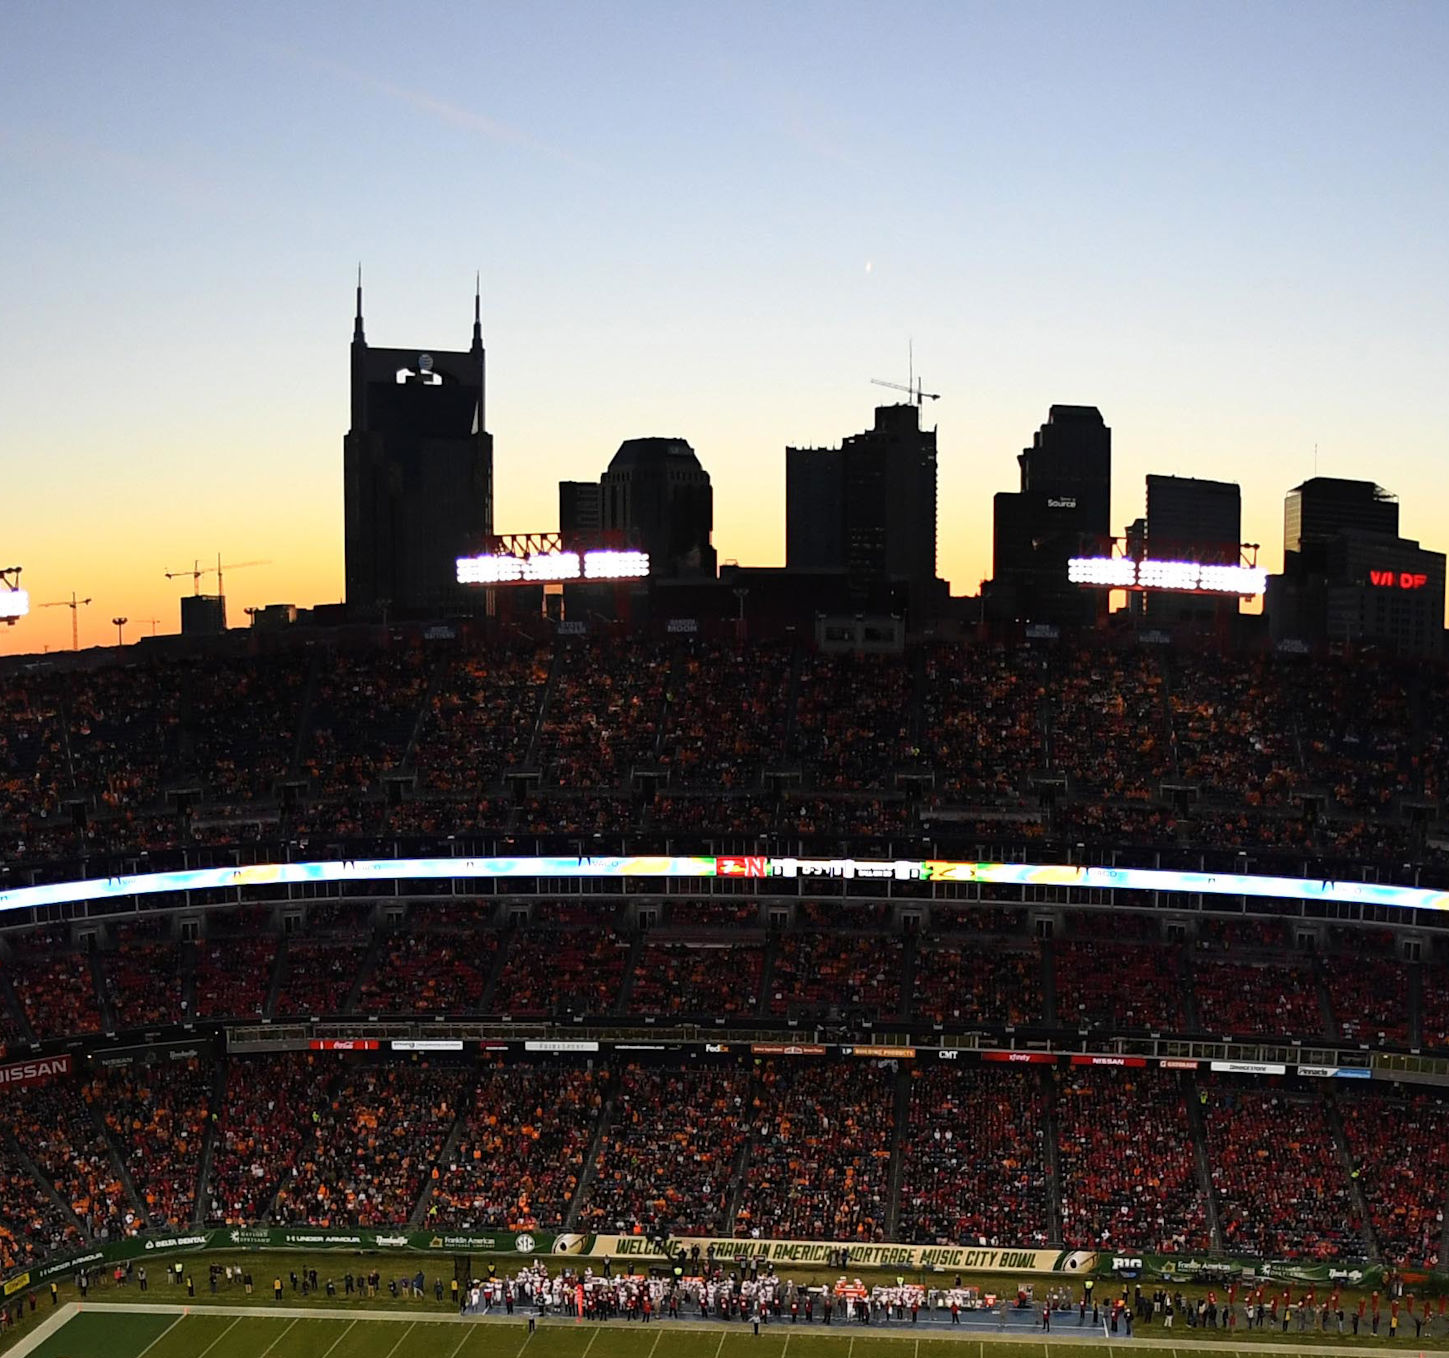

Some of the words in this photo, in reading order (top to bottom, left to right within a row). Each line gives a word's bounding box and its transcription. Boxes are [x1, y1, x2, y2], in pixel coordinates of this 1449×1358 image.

[1047, 498, 1076, 508] Source
[706, 1044, 729, 1053] FedEx
[939, 1051, 958, 1060] CMT
[1009, 1053, 1031, 1062] xfinity
[1092, 1057, 1125, 1065] NISSAN
[155, 1239, 177, 1248] DELTA
[177, 1236, 207, 1246] DENTAL
[296, 1235, 323, 1243] UNDER
[444, 1236, 468, 1244] Franklin
[469, 1236, 495, 1245] American
[616, 1238, 683, 1256] WELCOME
[709, 1241, 770, 1258] FRANKLIN
[772, 1244, 840, 1263] AMERICA
[846, 1245, 915, 1263] MORTGAGE
[919, 1248, 962, 1266] MUSIC
[965, 1250, 998, 1267] CITY
[998, 1251, 1037, 1269] BOWL
[47, 1261, 71, 1275] UNDER
[71, 1251, 104, 1268] ARMOUR
[1202, 1262, 1231, 1272] American
